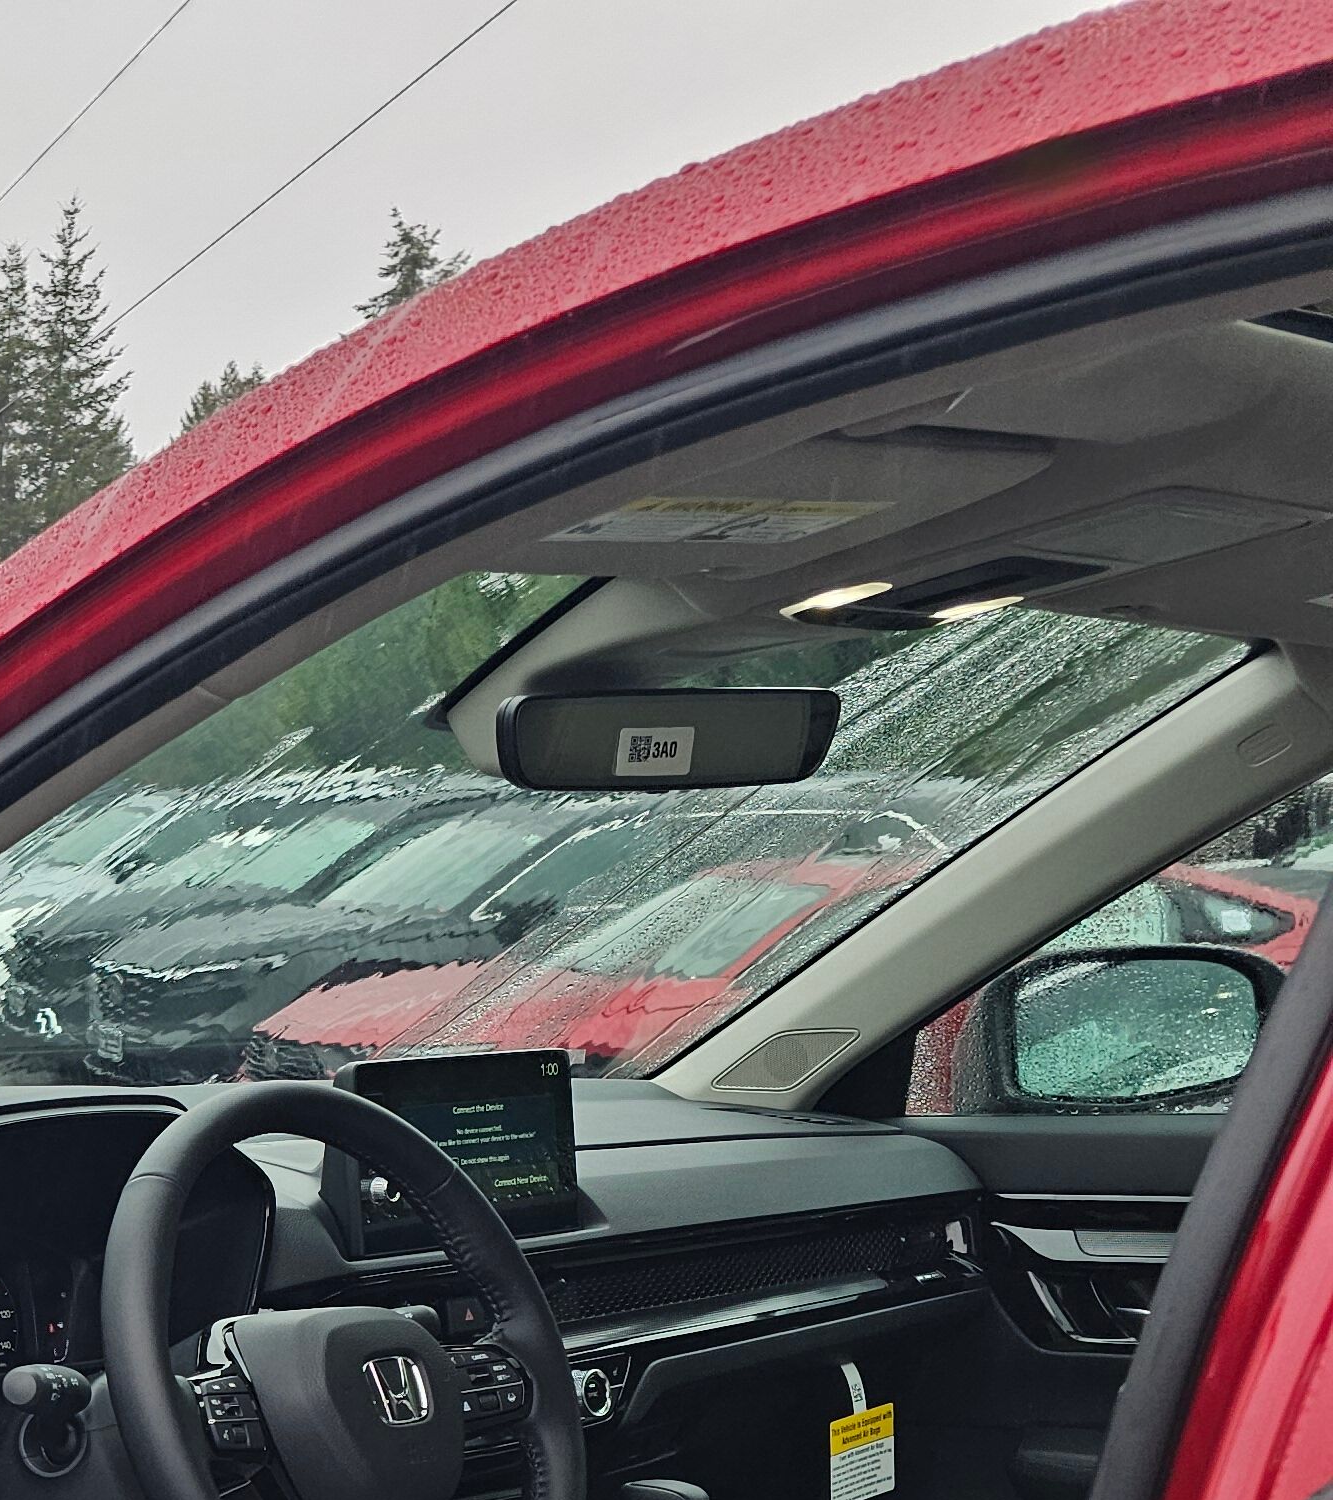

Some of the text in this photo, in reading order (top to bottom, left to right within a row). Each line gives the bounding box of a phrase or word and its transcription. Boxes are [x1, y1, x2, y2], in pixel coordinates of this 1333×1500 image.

[652, 741, 678, 759] 3A0
[540, 1063, 559, 1077] 1:00
[452, 1103, 505, 1115] Connect the Device
[456, 1128, 464, 1136] No
[494, 1174, 549, 1188] Connect New Device
[0, 1309, 12, 1319] 120
[0, 1340, 12, 1350] 140
[841, 1422, 856, 1434] Vehicle
[862, 1414, 882, 1428] Equipped
[883, 1410, 893, 1420] with
[842, 1430, 863, 1444] Advanced
